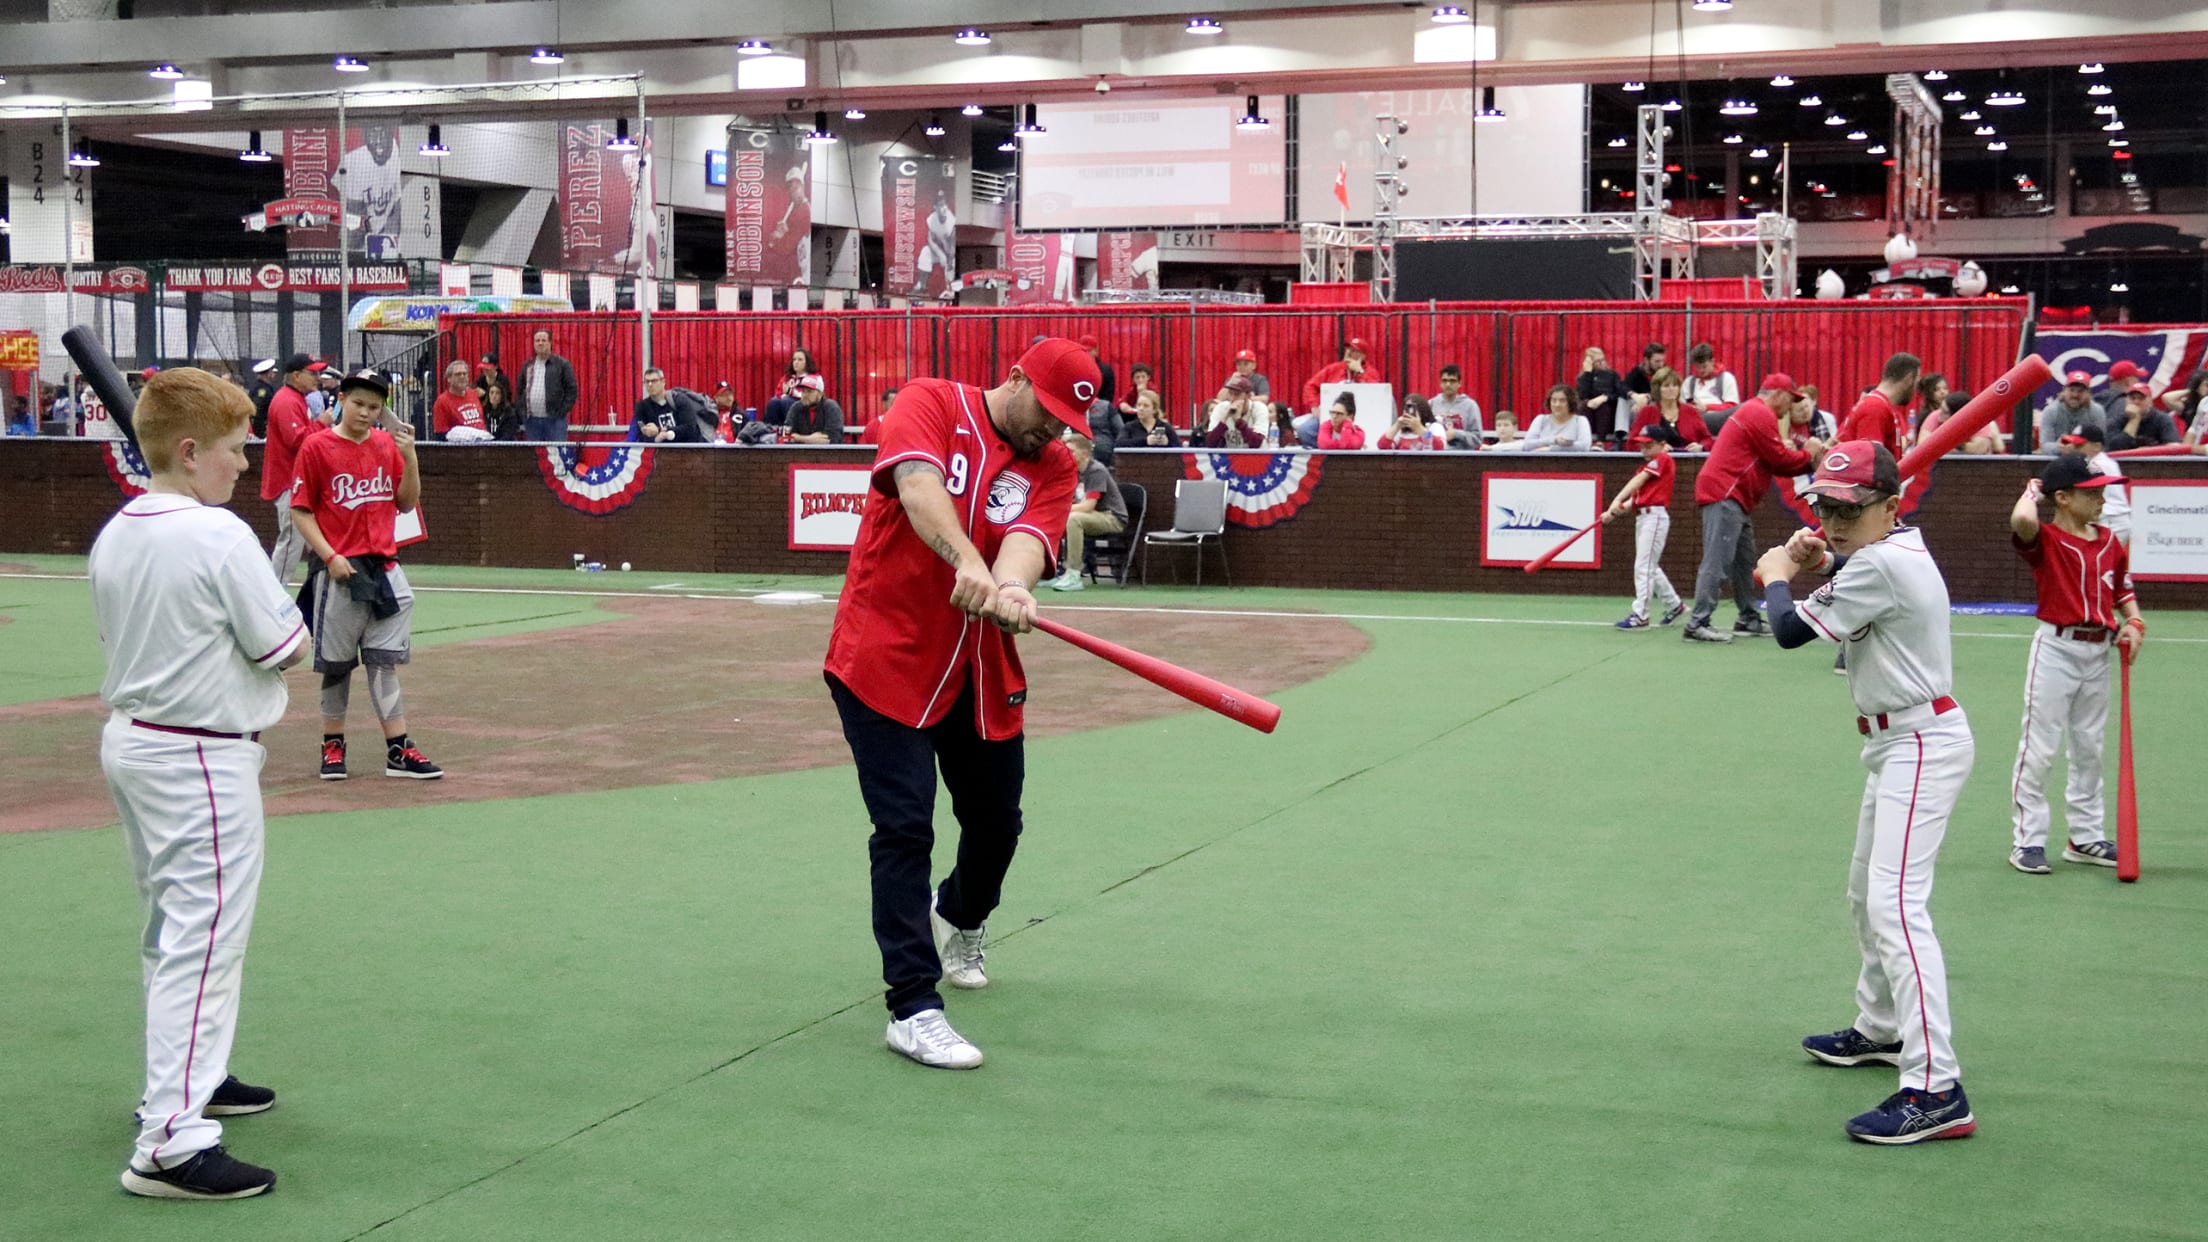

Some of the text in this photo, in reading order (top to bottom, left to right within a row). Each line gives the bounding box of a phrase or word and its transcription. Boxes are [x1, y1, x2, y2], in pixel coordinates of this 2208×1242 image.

[567, 124, 601, 249] PEREZ
[310, 204, 338, 213] CAGES
[735, 149, 765, 273] ROBINSON
[894, 178, 917, 284] KLUSZEWSKI
[1174, 233, 1216, 247] EXIT
[726, 229, 736, 277] FRANK
[0, 267, 62, 292] Reds
[169, 268, 251, 285] THANK YOU FANS
[289, 268, 312, 285] BEST
[315, 268, 340, 285] FANS
[356, 267, 406, 285] BASEBALL
[84, 404, 108, 421] 30
[332, 466, 394, 504] Reds
[946, 453, 968, 496] 9
[800, 492, 867, 520] RUMPK
